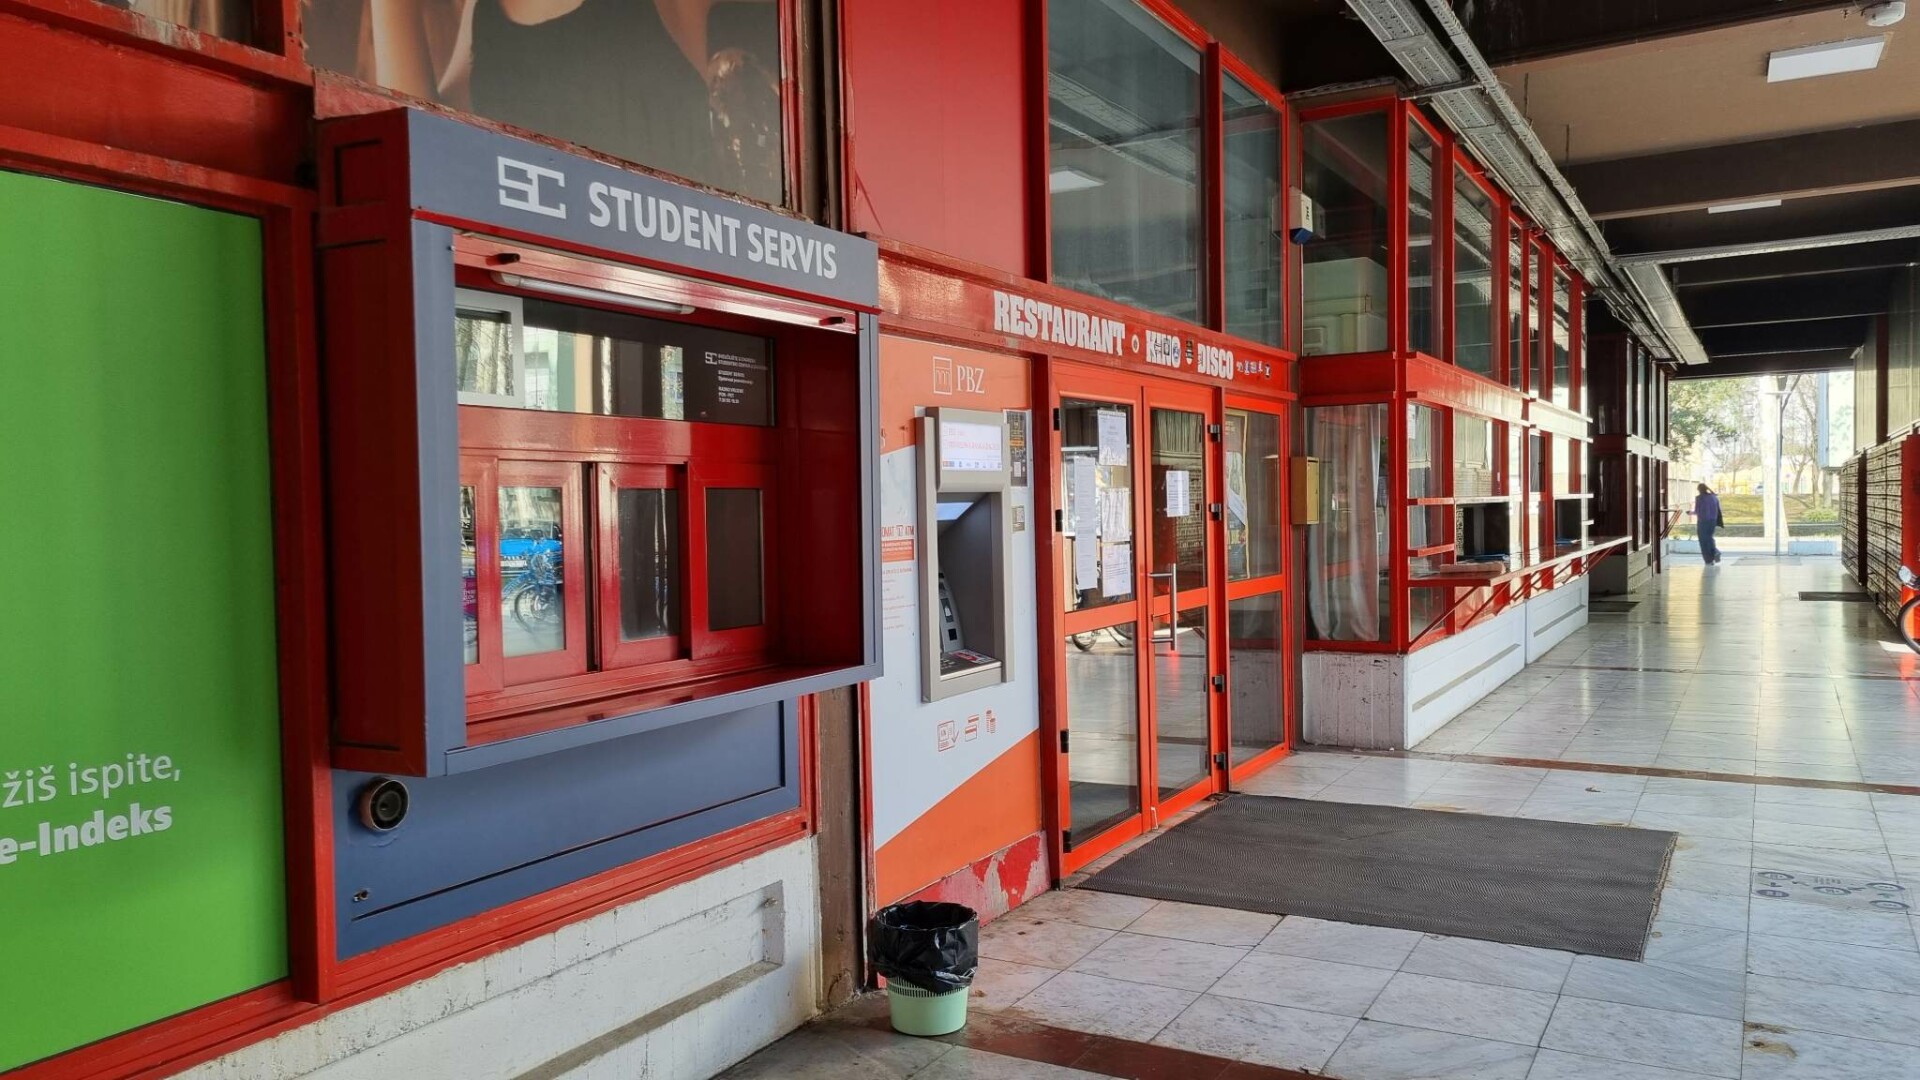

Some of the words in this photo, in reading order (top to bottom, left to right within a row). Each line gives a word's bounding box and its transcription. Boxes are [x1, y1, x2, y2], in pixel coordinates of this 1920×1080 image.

[588, 181, 741, 257] STUDENT
[747, 223, 837, 280] SERVIS
[993, 290, 1126, 356] RESTAURANT
[1145, 329, 1181, 368] KINO
[1197, 343, 1234, 380] DISCO
[957, 365, 985, 394] PBZ
[69, 753, 181, 799] ispite,
[0, 802, 173, 865] e-Indeks
